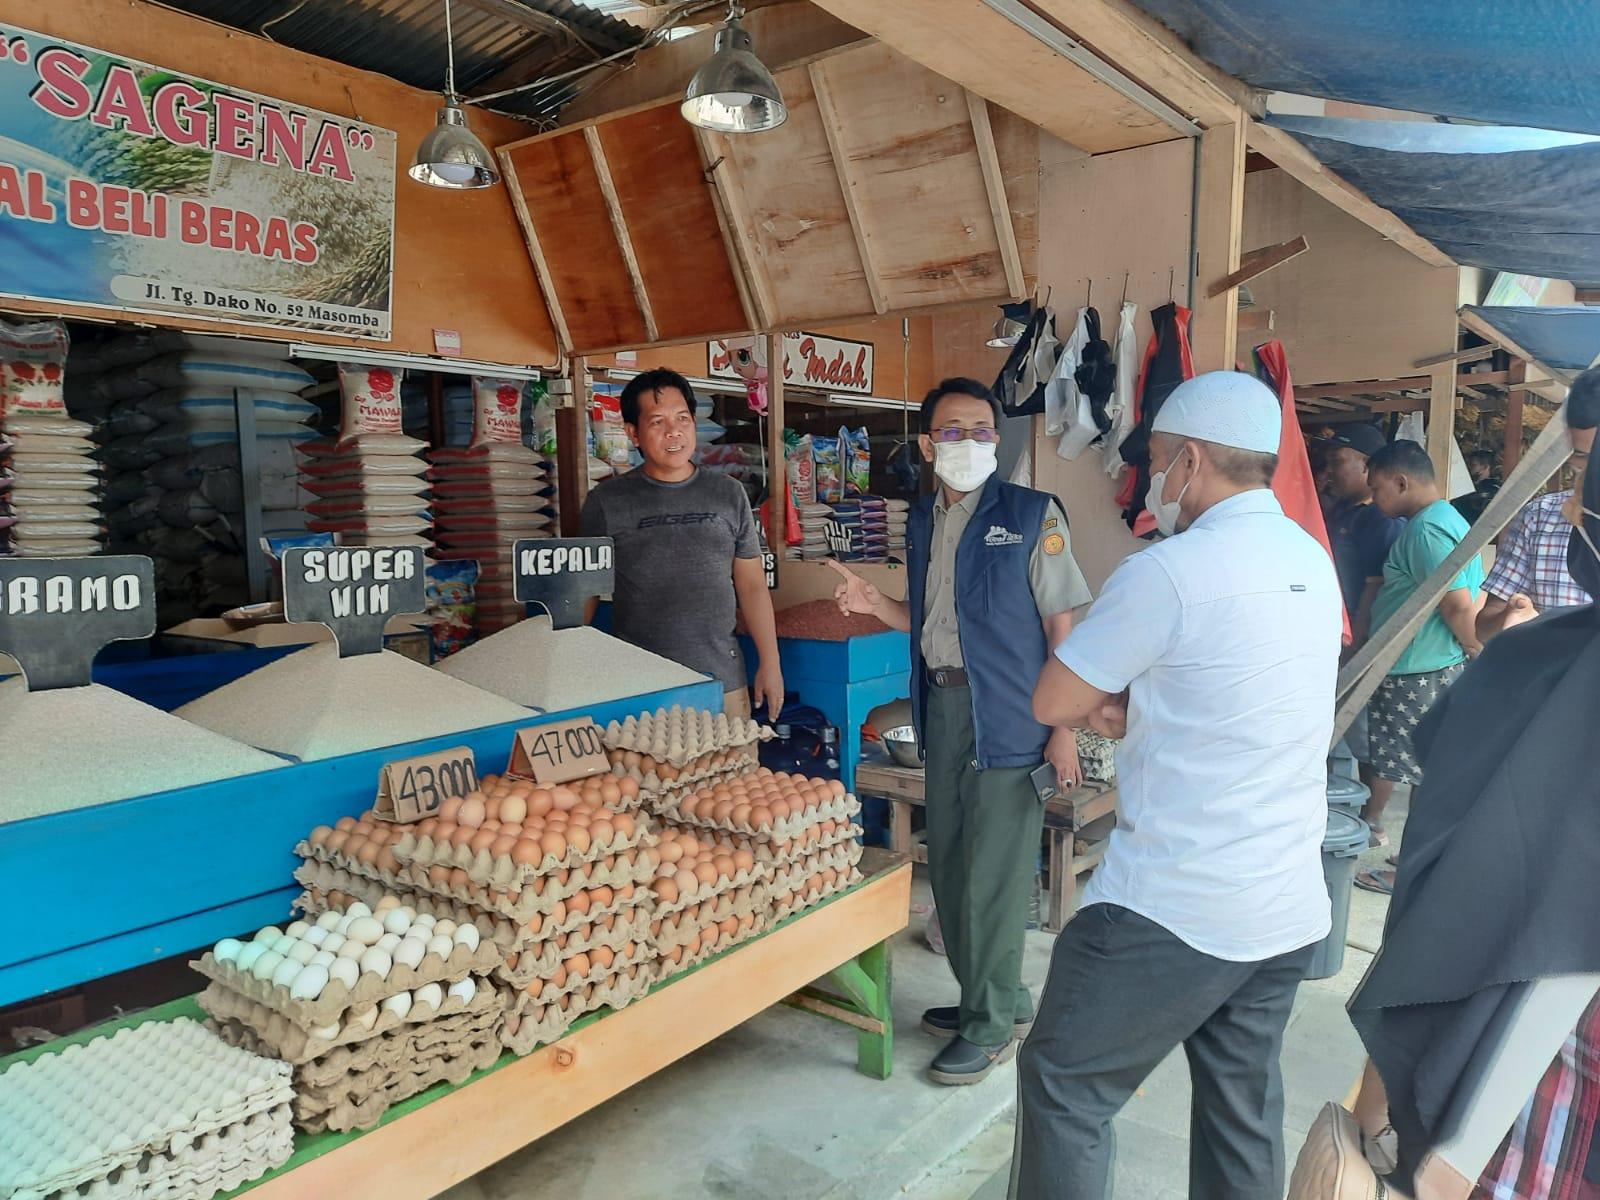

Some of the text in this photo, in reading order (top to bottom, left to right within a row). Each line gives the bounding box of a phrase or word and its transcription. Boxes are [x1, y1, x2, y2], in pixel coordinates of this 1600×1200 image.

[68, 179, 167, 240] BELI
[180, 201, 319, 264] BERAS
[145, 283, 380, 327] Jl. Tg. Dako No. 52 Masomba
[638, 512, 717, 529] EIGER
[303, 549, 415, 583] SUPER
[520, 545, 612, 575] KEPALA
[0, 573, 141, 615] RAMO
[330, 583, 390, 618] WIN
